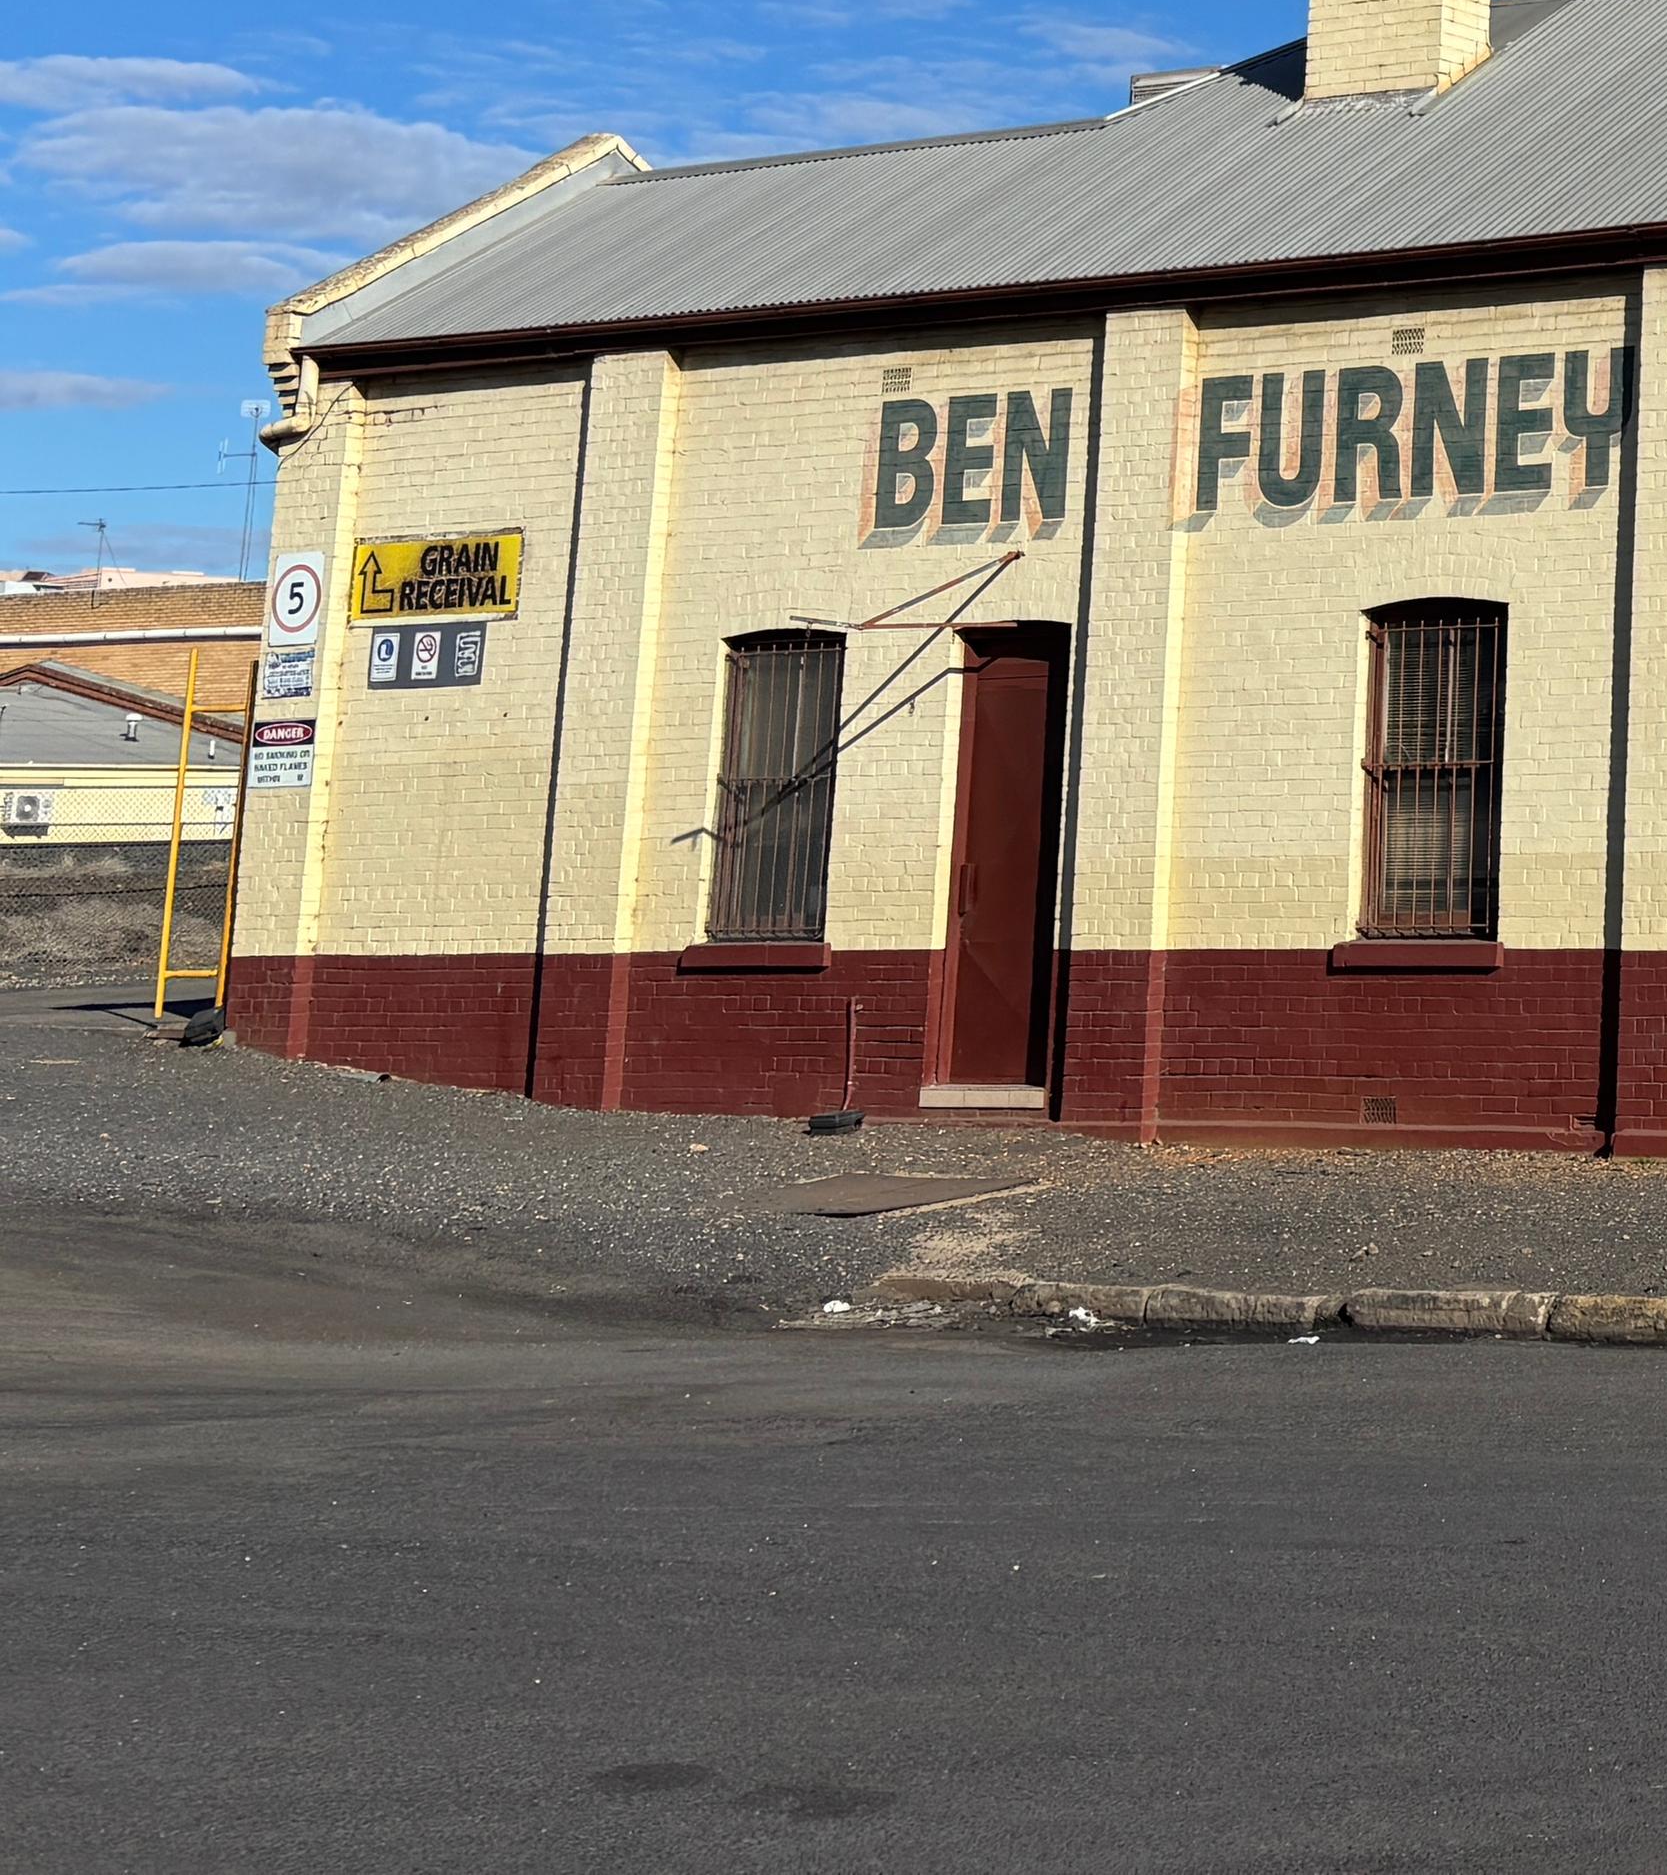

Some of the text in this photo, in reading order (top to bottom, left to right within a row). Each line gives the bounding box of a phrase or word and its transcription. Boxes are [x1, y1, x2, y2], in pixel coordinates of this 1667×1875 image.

[866, 387, 1073, 537] BEN
[1184, 345, 1636, 522] FURNEY
[420, 541, 499, 576] GRAIN
[288, 582, 305, 615] 5
[400, 575, 512, 612] RECEIVAL
[263, 727, 305, 740] DANGER
